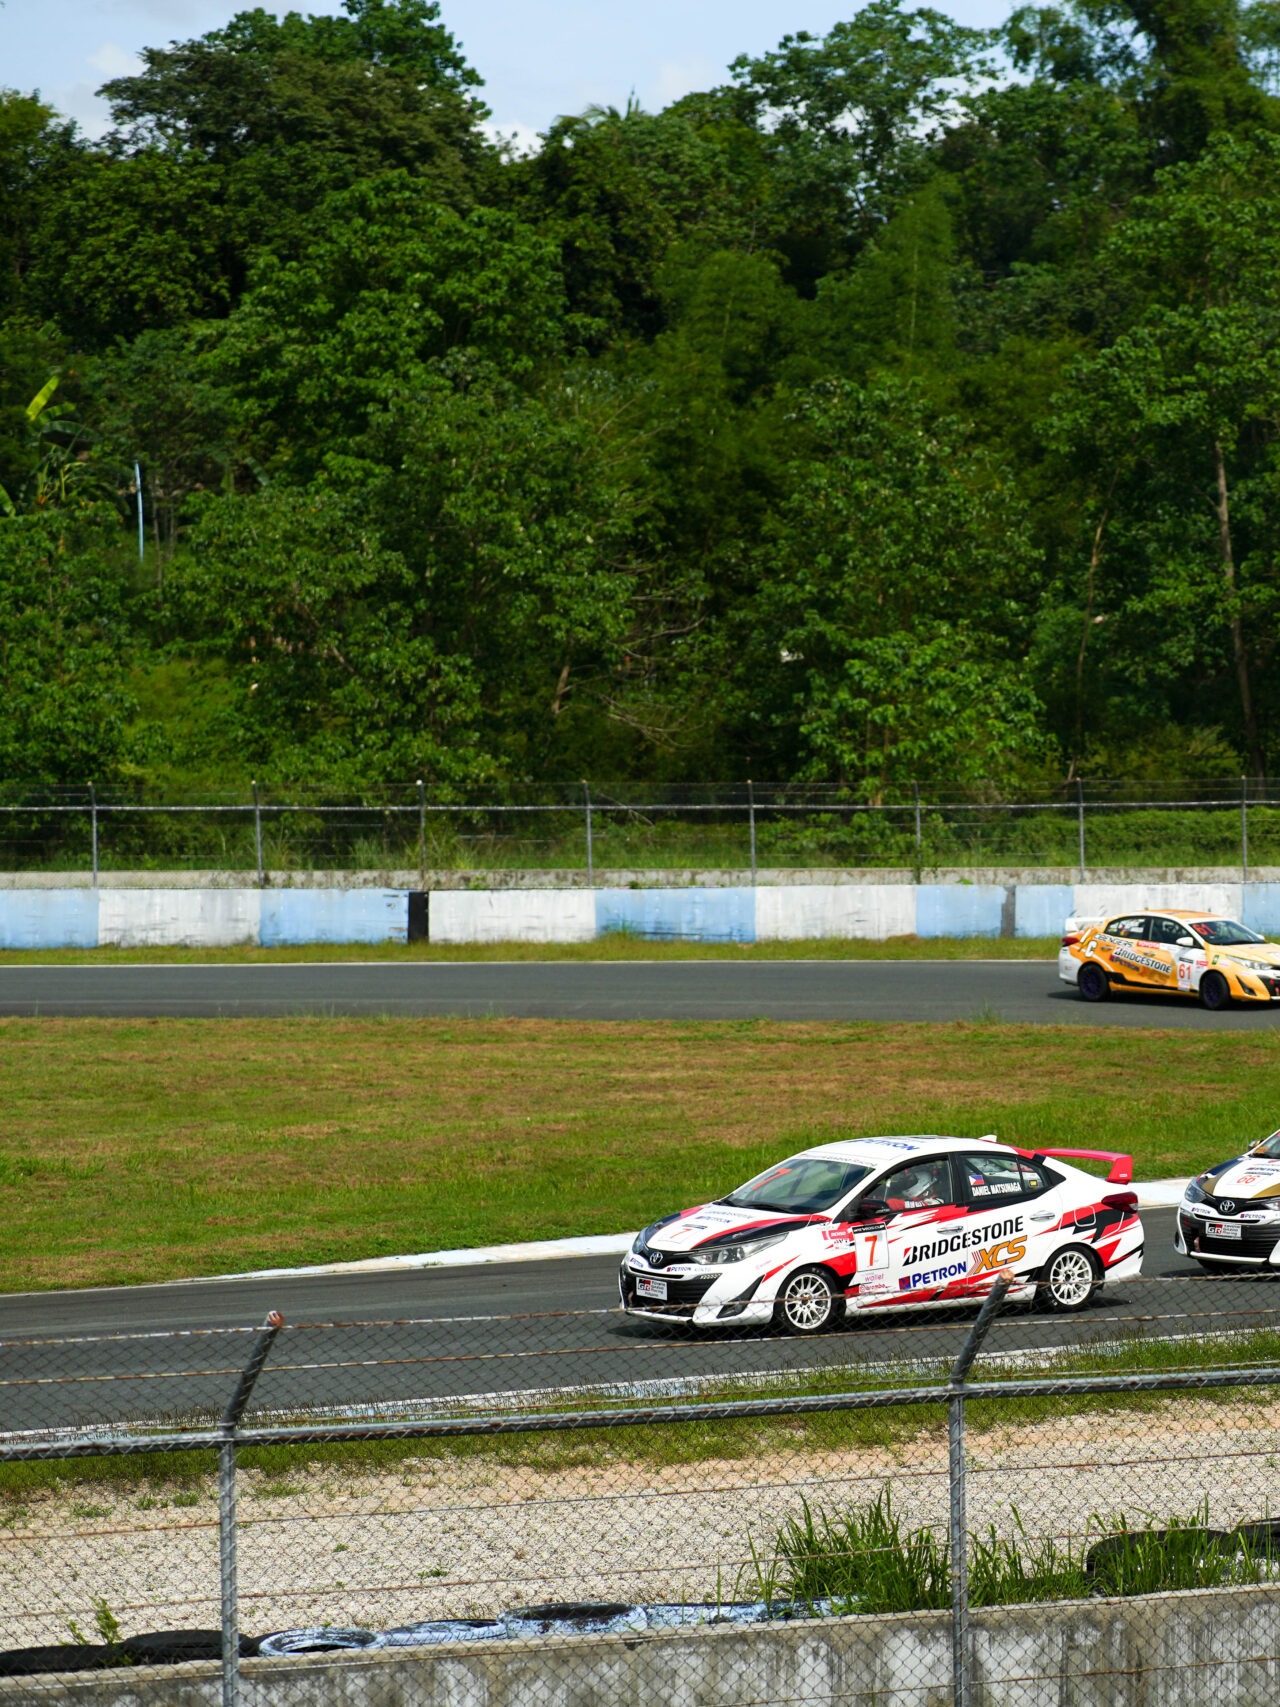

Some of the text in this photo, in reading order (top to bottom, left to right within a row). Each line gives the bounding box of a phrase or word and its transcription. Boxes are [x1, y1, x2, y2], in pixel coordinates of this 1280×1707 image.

[1192, 923, 1215, 936] 61
[1114, 947, 1172, 974] BRIDGESTONE
[1179, 963, 1191, 980] 61
[752, 1167, 792, 1191] 7
[972, 1182, 1022, 1197] DANIEL MATSUNAGA
[1236, 1174, 1260, 1184] 66
[864, 1235, 878, 1267] 7
[902, 1216, 1024, 1267] BRIDGESTONE
[973, 1235, 1028, 1275] XCS
[911, 1261, 967, 1288] PETRON
